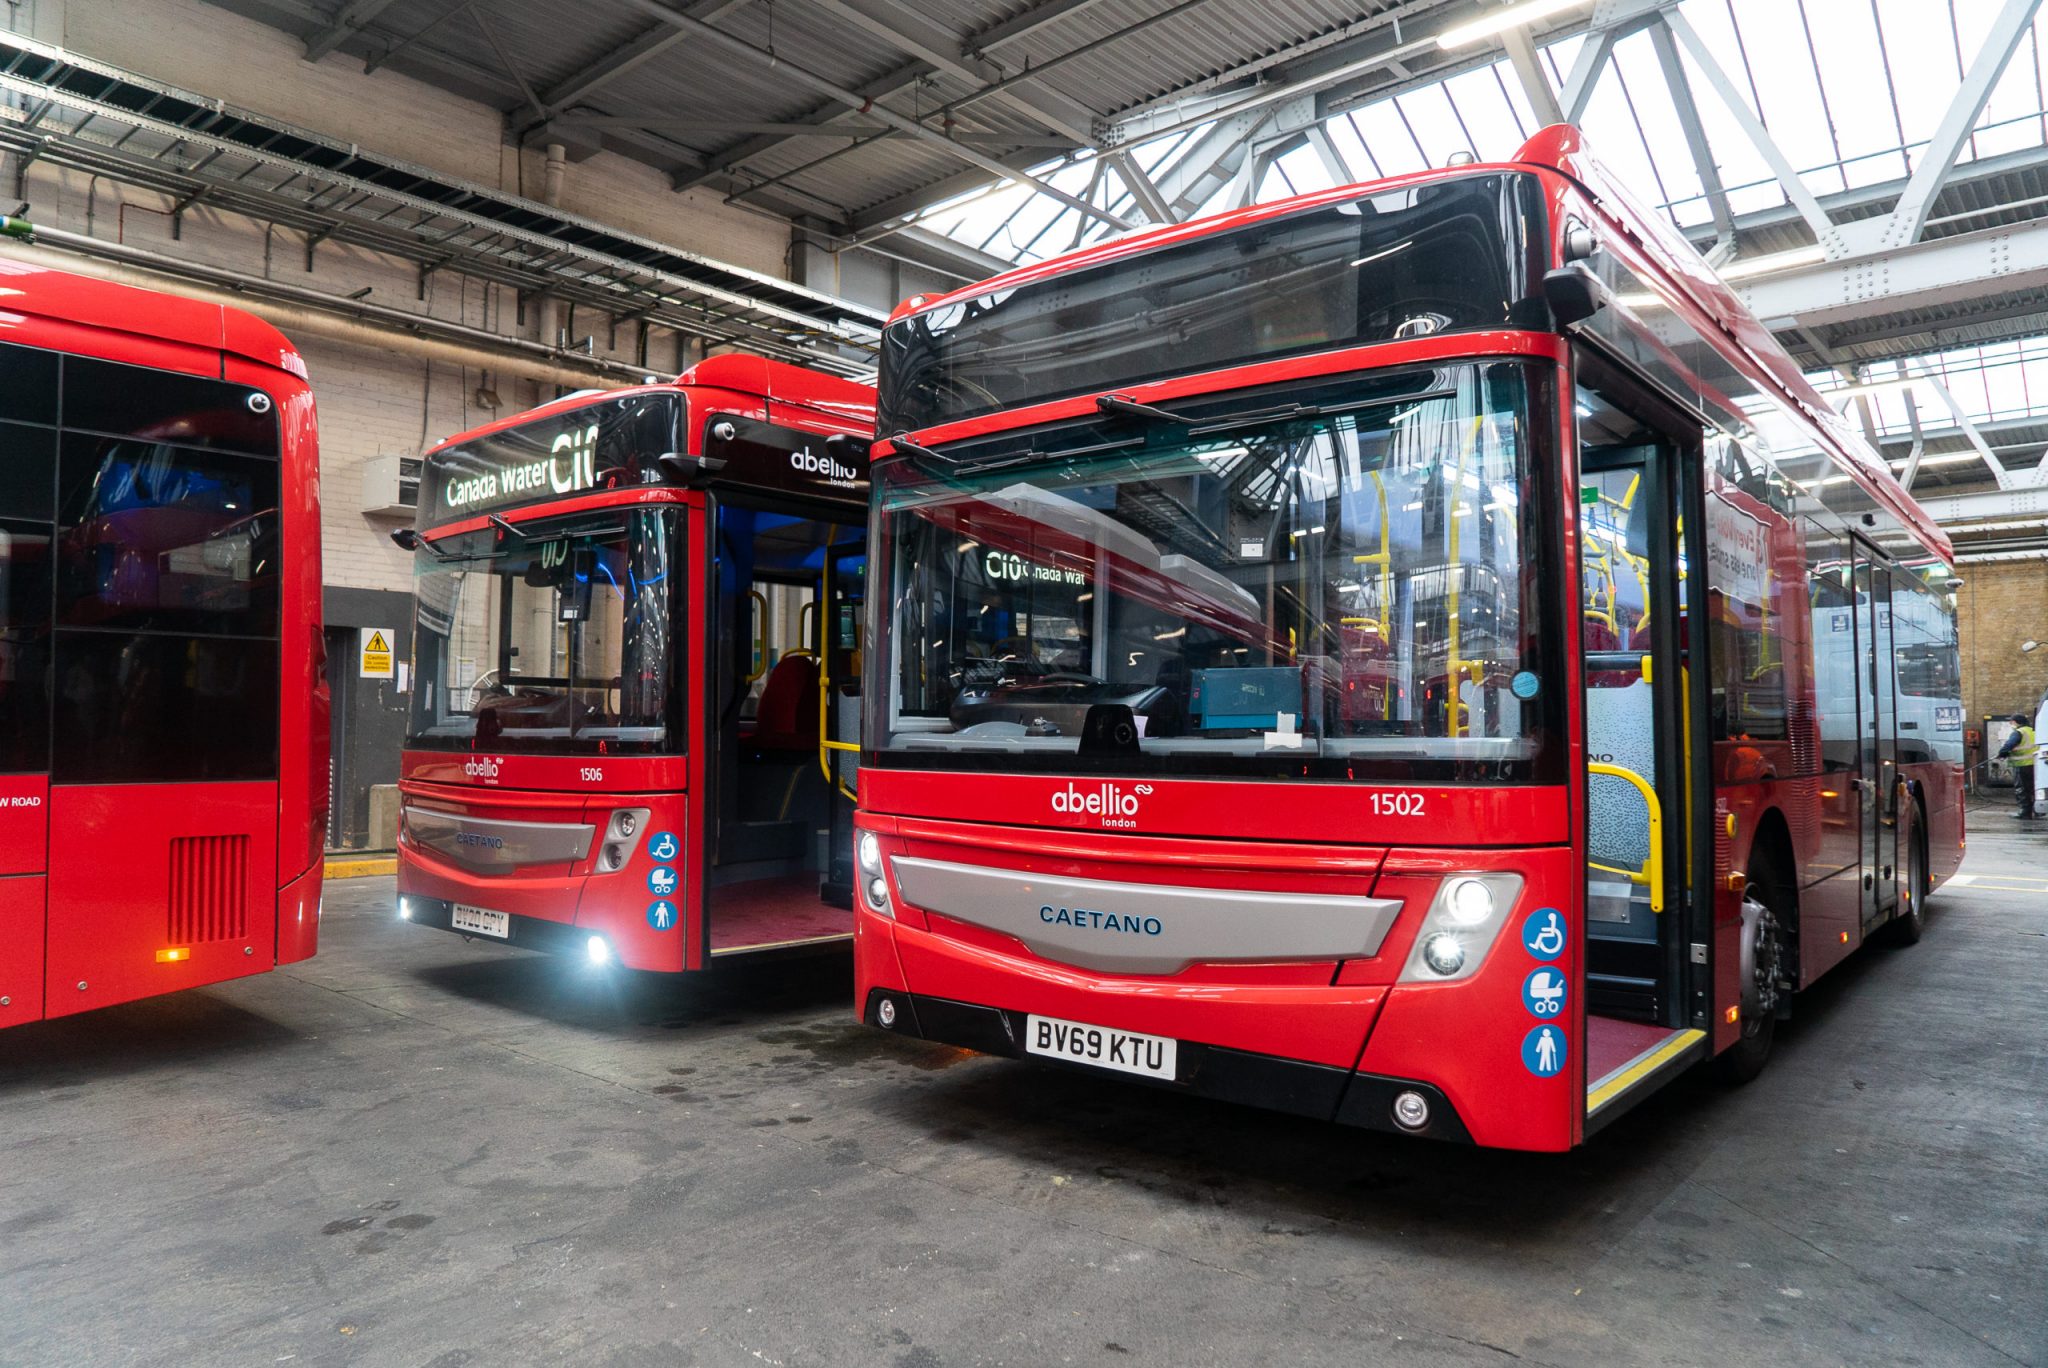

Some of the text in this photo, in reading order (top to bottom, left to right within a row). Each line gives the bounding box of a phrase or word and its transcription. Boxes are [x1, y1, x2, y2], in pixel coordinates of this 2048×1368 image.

[447, 459, 548, 506] Canada Water
[830, 478, 855, 489] london
[465, 756, 499, 777] abellio
[580, 768, 603, 781] 1506
[11, 796, 41, 807] ROAD
[1051, 782, 1139, 816] abellio
[1370, 793, 1426, 816] 1502
[1102, 817, 1137, 828] london
[456, 832, 503, 849] CAETANO
[1039, 905, 1162, 936] CAETANO
[1037, 1020, 1164, 1071] BV69 KTU
